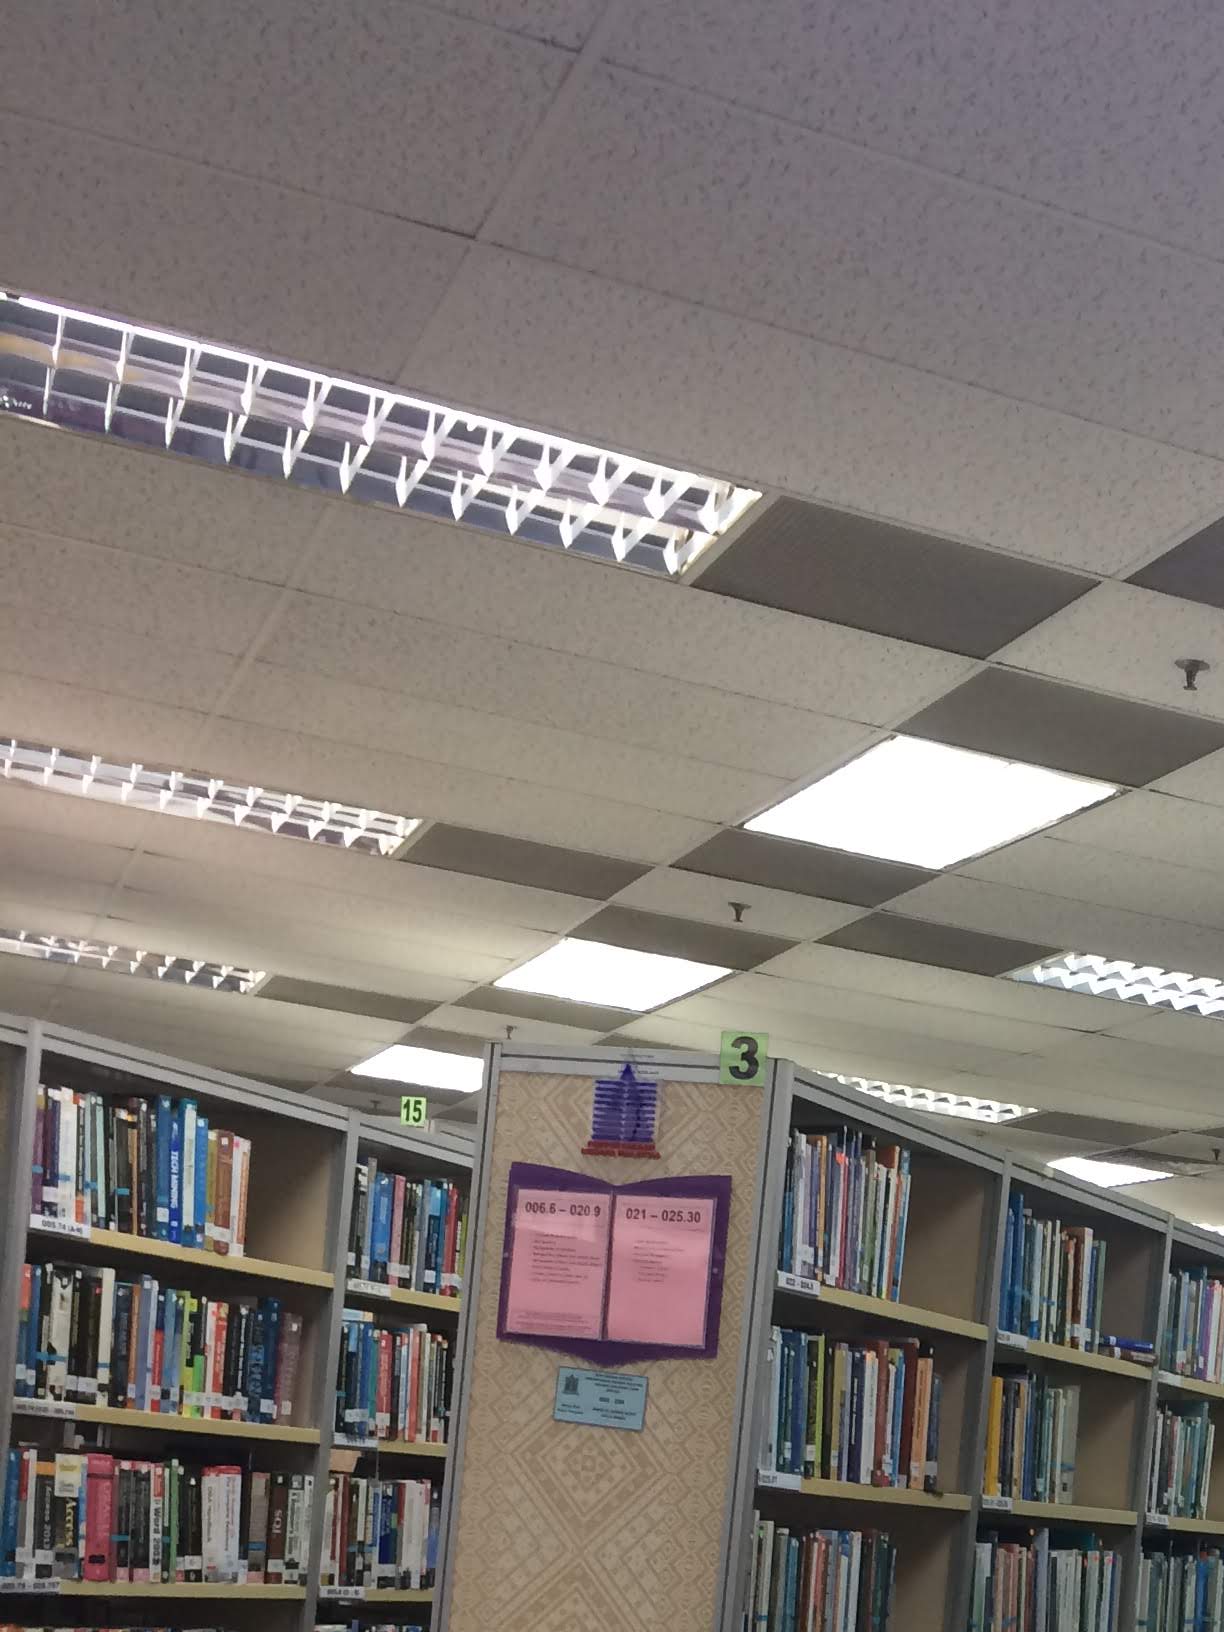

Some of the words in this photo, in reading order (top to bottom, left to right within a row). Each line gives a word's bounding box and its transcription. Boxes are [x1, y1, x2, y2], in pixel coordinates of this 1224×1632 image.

[729, 1036, 759, 1080] 3
[403, 1099, 422, 1122] 15
[626, 1207, 646, 1220] 021
[661, 1209, 701, 1223] 025.30
[65, 1501, 77, 1547] Access
